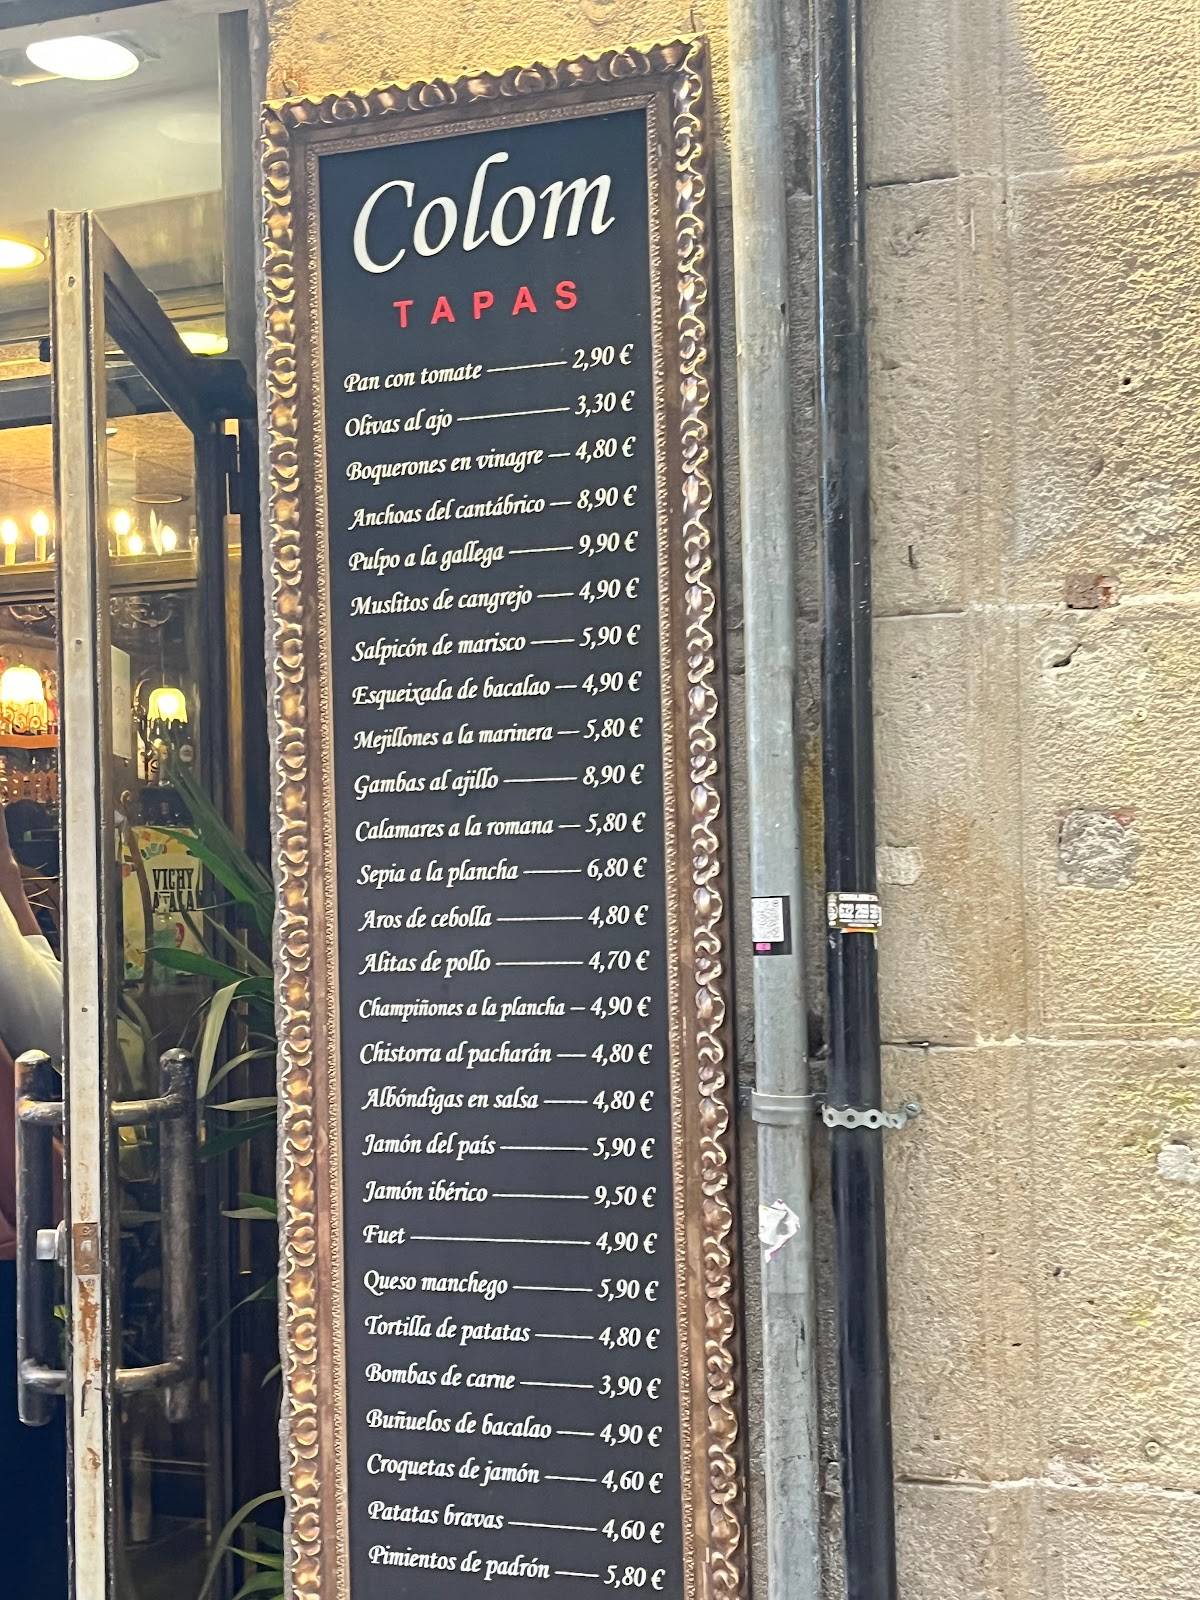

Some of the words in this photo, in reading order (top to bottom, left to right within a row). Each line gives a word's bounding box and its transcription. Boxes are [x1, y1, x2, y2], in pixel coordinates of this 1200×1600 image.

[353, 151, 616, 274] Colom
[393, 280, 578, 328] TAPAS
[343, 372, 381, 393] Pan
[384, 371, 416, 389] con
[420, 363, 483, 385] tomate
[571, 345, 615, 372] 2,90
[618, 343, 634, 366] €
[344, 413, 401, 437] Olivas
[403, 407, 427, 432] al
[425, 408, 453, 437] ajo
[574, 391, 617, 418] 3,30
[620, 389, 636, 412] €
[345, 458, 448, 486] Boquerones
[450, 456, 472, 472] en
[475, 447, 544, 474] vinagre
[574, 437, 618, 464] 4,80
[621, 435, 637, 458] €
[347, 503, 423, 531] Anchoas
[425, 498, 456, 522] del
[454, 493, 546, 520] cantábrico
[576, 486, 619, 513] 8,90
[622, 484, 638, 507] €
[348, 547, 401, 577] Pulpo
[403, 552, 417, 568] a
[419, 543, 438, 566] la
[439, 539, 505, 572] gallega
[577, 531, 621, 558] 9,90
[623, 530, 639, 553] €
[349, 590, 430, 617] Muslitos
[432, 587, 455, 611] de
[457, 584, 533, 614] cangrejo
[578, 578, 622, 604] 4,90
[624, 576, 640, 599] €
[350, 636, 429, 666] Salpicón
[431, 632, 454, 656] de
[457, 631, 527, 654] marisco
[578, 625, 623, 651] 5,90
[626, 623, 641, 646] €
[351, 678, 454, 711] Esqueixada
[456, 676, 479, 700] de
[482, 673, 551, 699] bacalao
[581, 671, 624, 697] 4,90
[627, 670, 643, 692] €
[352, 725, 440, 755] Mejillones
[441, 731, 455, 745] a
[457, 722, 475, 745] la
[478, 722, 554, 744] marinera
[582, 717, 626, 743] 5,80
[628, 716, 644, 739] €
[353, 770, 427, 801] Gambas
[428, 768, 453, 791] al
[451, 766, 499, 797] ajillo
[582, 764, 626, 789] 8,90
[629, 763, 645, 785] €
[355, 817, 446, 843] Calamares
[447, 822, 461, 837] a
[464, 814, 483, 837] la
[486, 819, 555, 836] romana
[584, 812, 628, 837] 5,80
[631, 811, 647, 833] €
[152, 868, 194, 890] VICHY
[356, 862, 407, 890] Sepia
[409, 867, 422, 882] a
[425, 859, 444, 882] la
[445, 857, 520, 889] plancha
[586, 857, 629, 882] 6,80
[632, 856, 648, 879] €
[357, 909, 403, 932] Aros
[405, 906, 427, 929] de
[430, 904, 493, 928] cebolla
[587, 904, 631, 929] 4,80
[633, 904, 649, 926] €
[357, 950, 418, 976] Alitas
[420, 949, 442, 972] de
[443, 948, 491, 979] pollo
[588, 949, 632, 974] 4,70
[635, 949, 651, 972] €
[358, 996, 465, 1023] Champiñones
[466, 1003, 478, 1016] a
[480, 995, 498, 1016] la
[497, 995, 566, 1023] plancha
[589, 995, 633, 1020] 4,90
[636, 995, 652, 1018] €
[359, 1040, 442, 1065] Chistorra
[445, 1040, 469, 1063] al
[465, 1040, 553, 1070] pacharán
[590, 1043, 635, 1067] 4,80
[637, 1043, 653, 1065] €
[360, 1085, 465, 1115] Albóndigas
[467, 1093, 490, 1109] en
[492, 1085, 540, 1109] salsa
[592, 1089, 636, 1114] 4,80
[639, 1090, 655, 1112] €
[361, 1133, 423, 1156] Jamón
[425, 1131, 459, 1154] del
[455, 1134, 497, 1162] país
[592, 1136, 637, 1161] 5,90
[640, 1137, 656, 1160] €
[362, 1180, 424, 1203] Jamón
[427, 1178, 489, 1202] ibérico
[593, 1185, 638, 1209] 9,50
[641, 1186, 657, 1208] €
[362, 1224, 406, 1245] Fuet
[595, 1231, 639, 1255] 4,90
[642, 1232, 658, 1255] €
[363, 1269, 417, 1297] Queso
[420, 1270, 509, 1301] manchego
[596, 1278, 641, 1302] 5,90
[644, 1280, 660, 1302] €
[364, 1313, 433, 1338] Tortilla
[435, 1315, 458, 1339] de
[458, 1322, 532, 1347] patatas
[598, 1326, 642, 1350] 4,80
[645, 1327, 661, 1350] €
[364, 1361, 438, 1386] Bombas
[440, 1363, 463, 1387] de
[465, 1372, 516, 1390] carne
[598, 1374, 643, 1399] 3,90
[645, 1377, 662, 1400] €
[365, 1408, 452, 1433] Buñuelos
[454, 1411, 477, 1434] de
[481, 1412, 552, 1439] bacalao
[599, 1423, 644, 1447] 4,90
[647, 1425, 663, 1448] €
[366, 1452, 456, 1482] Croquetas
[458, 1456, 481, 1480] de
[479, 1459, 541, 1487] jamón
[600, 1469, 645, 1493] 4,60
[648, 1472, 664, 1494] €
[367, 1500, 440, 1525] Patatas
[443, 1503, 505, 1530] bravas
[601, 1518, 646, 1543] 4,60
[649, 1521, 665, 1544] €
[367, 1544, 458, 1571] Pimientos
[459, 1549, 482, 1573] de
[483, 1554, 551, 1582] padrón
[603, 1564, 647, 1589] 5,80
[650, 1568, 666, 1591] €
